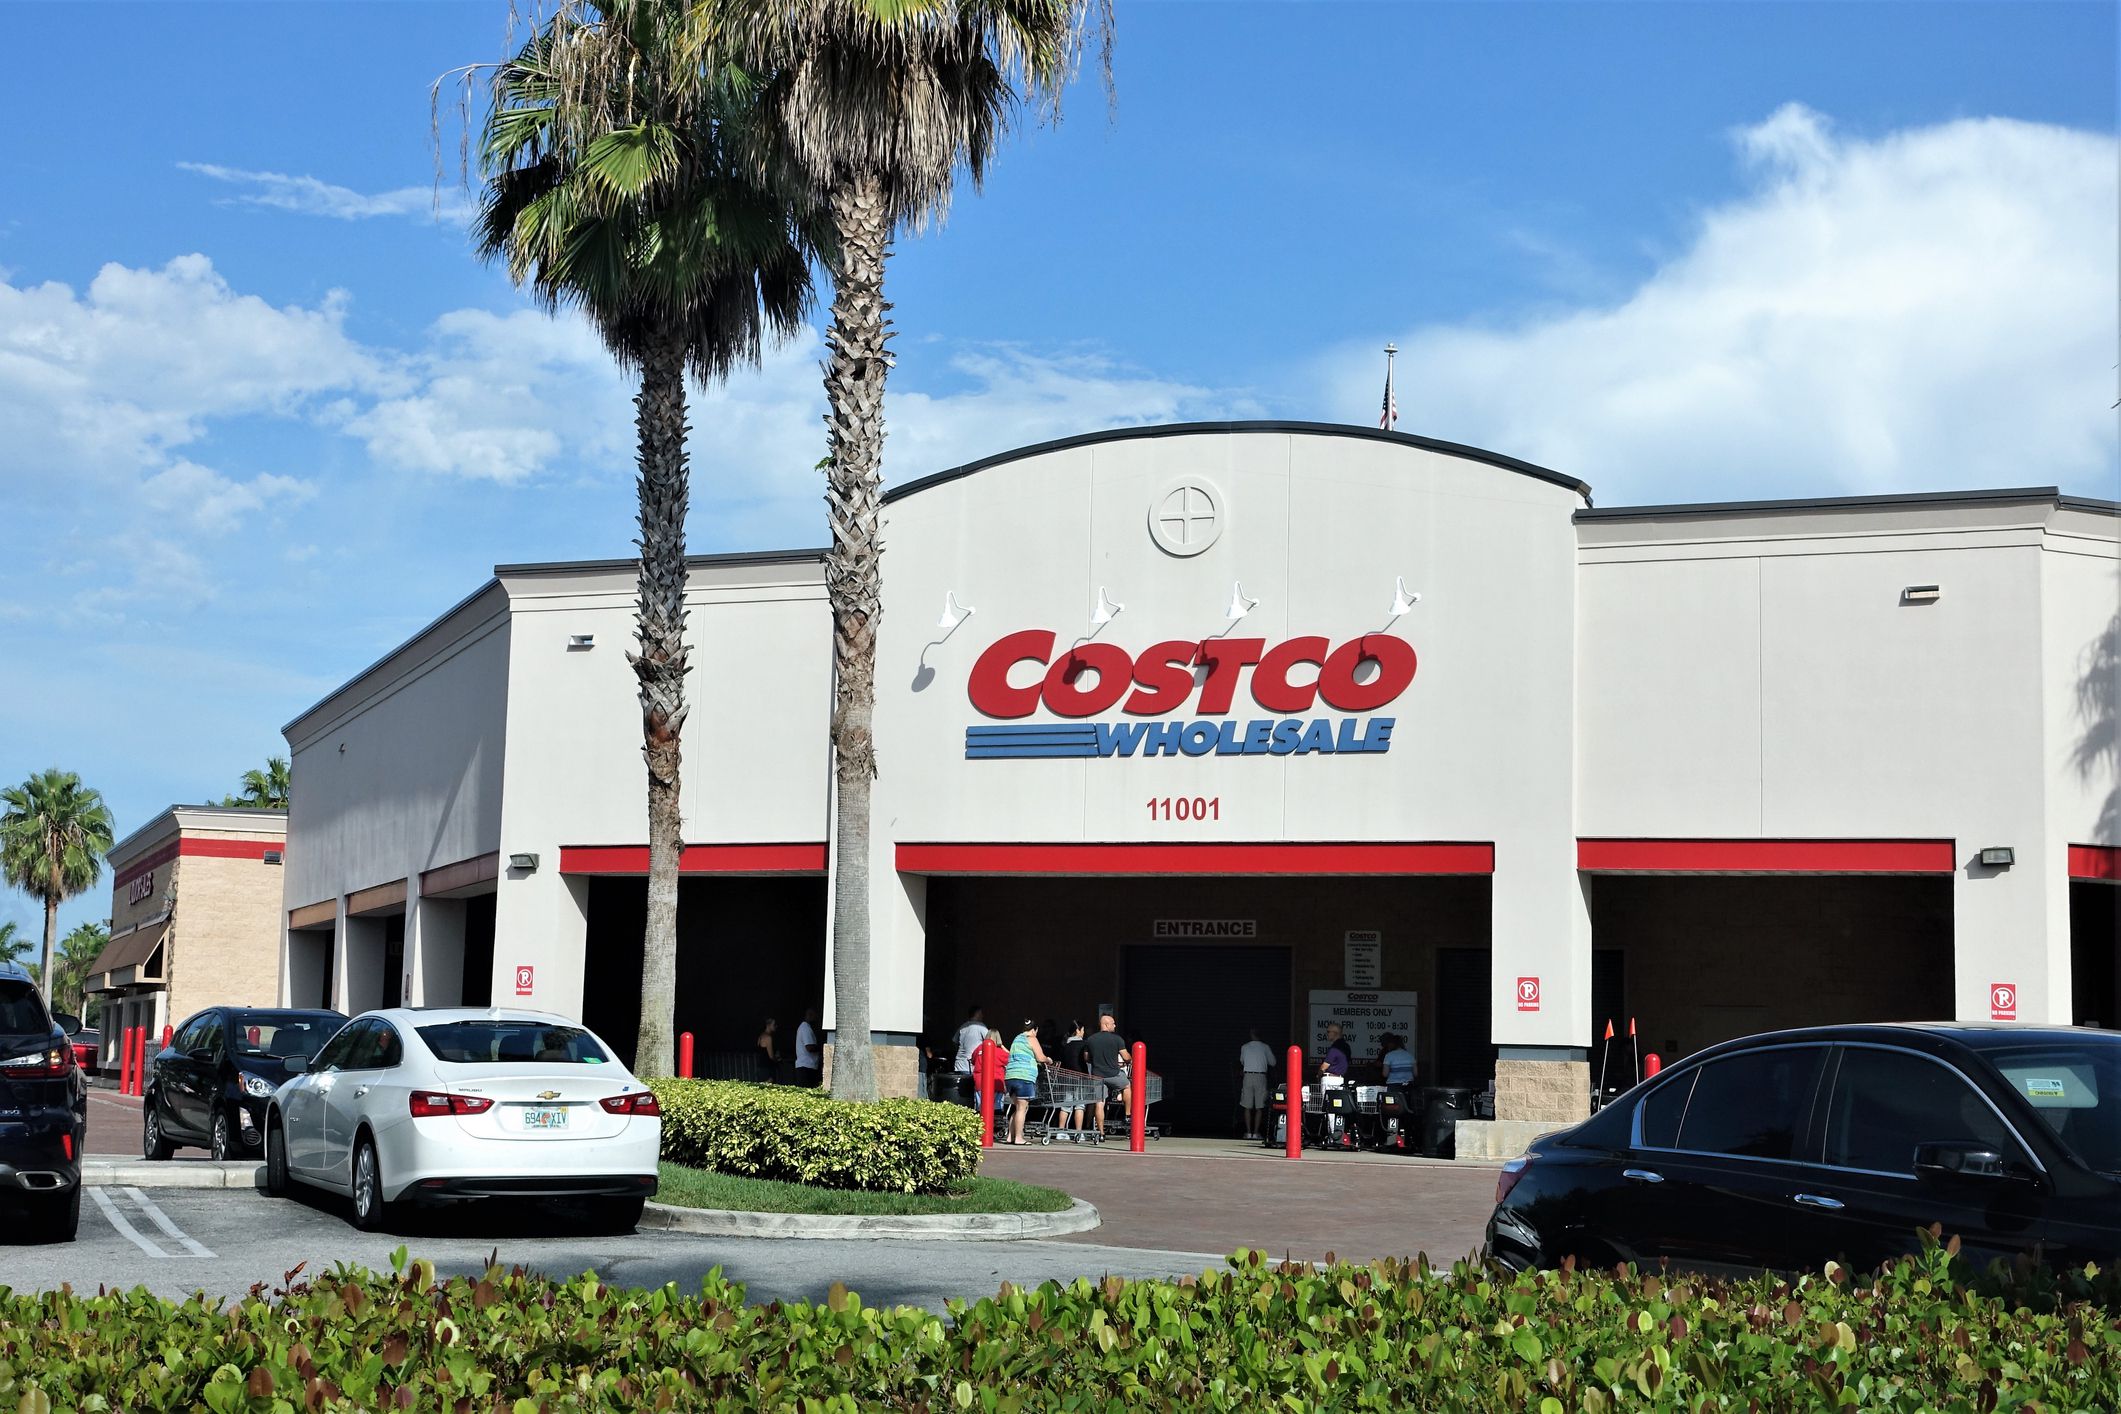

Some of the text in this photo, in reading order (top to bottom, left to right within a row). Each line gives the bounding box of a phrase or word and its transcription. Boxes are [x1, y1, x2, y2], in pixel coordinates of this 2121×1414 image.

[968, 629, 1418, 719] COSTCO
[1095, 717, 1396, 758] WHOLESALE
[1146, 797, 1220, 821] 11001
[1156, 921, 1254, 936] ENTRANCE
[1333, 1007, 1393, 1017] MEMBERS ONLY
[1341, 1020, 1354, 1029] FRI
[1366, 1021, 1386, 1030] 10:00
[1391, 1022, 1408, 1031] 8:30
[1317, 1033, 1357, 1042] SADAY
[1336, 1115, 1343, 1125] 3
[1390, 1118, 1397, 1128] 2
